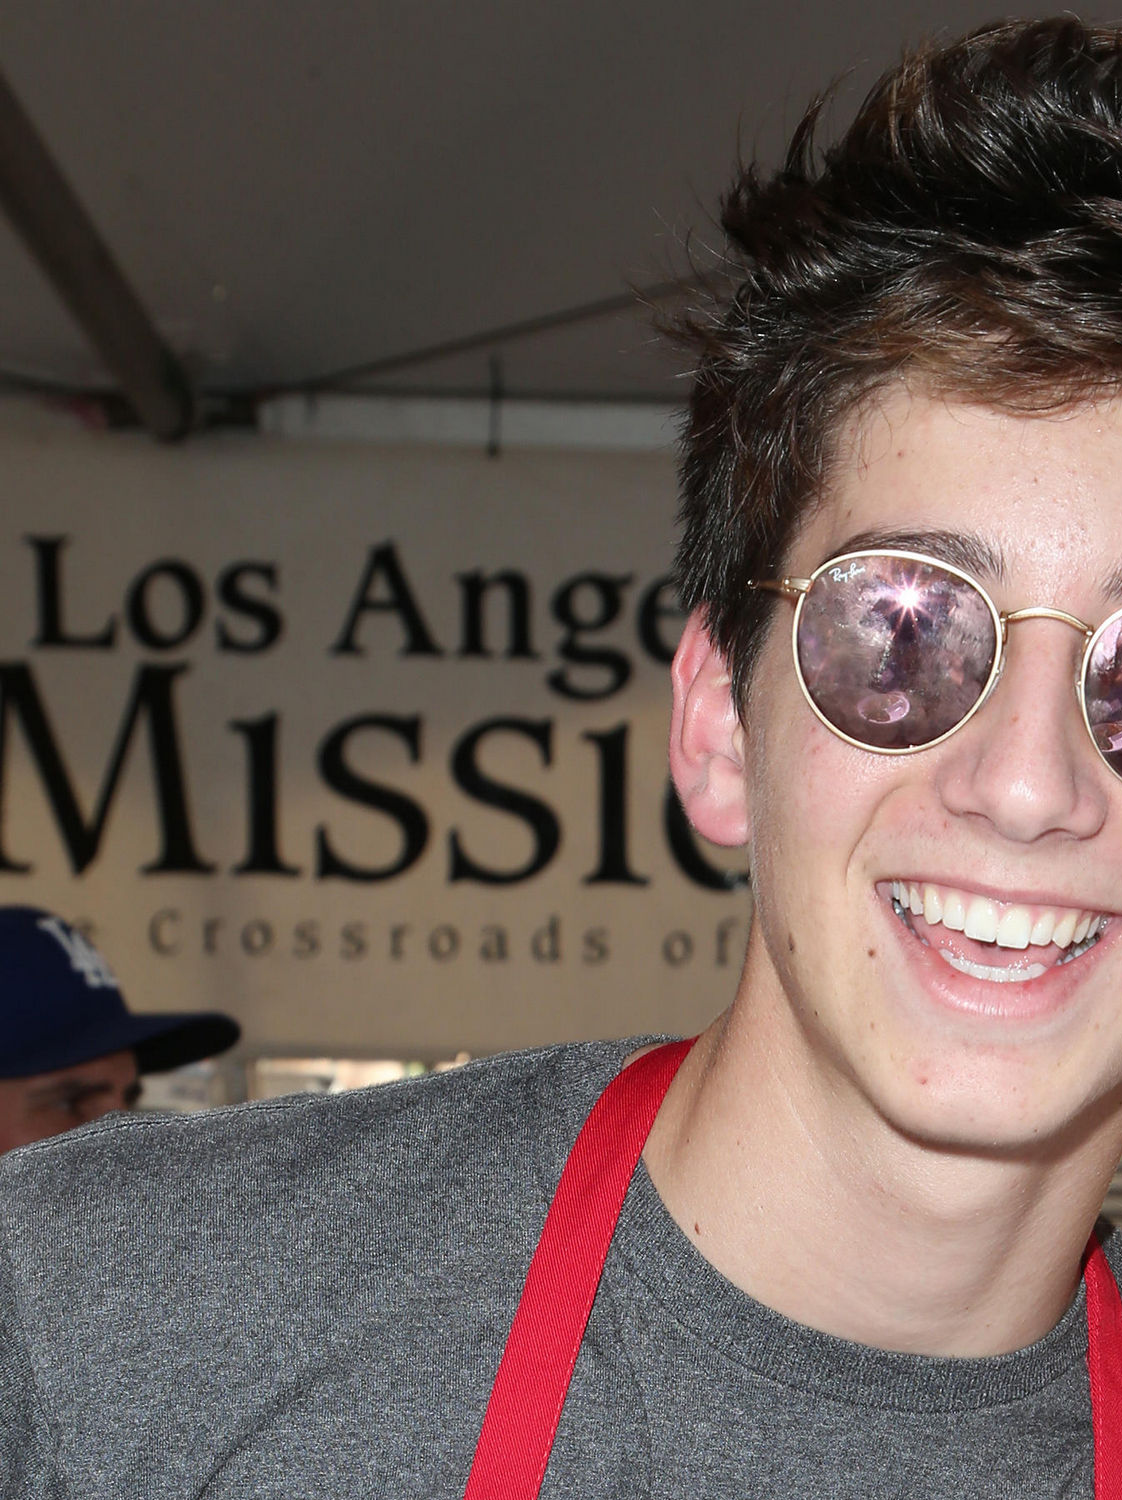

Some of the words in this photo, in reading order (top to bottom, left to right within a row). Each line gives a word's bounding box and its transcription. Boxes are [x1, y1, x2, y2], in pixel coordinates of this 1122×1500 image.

[24, 533, 283, 654] Los
[147, 908, 610, 965] Crossroads
[662, 914, 743, 967] of
